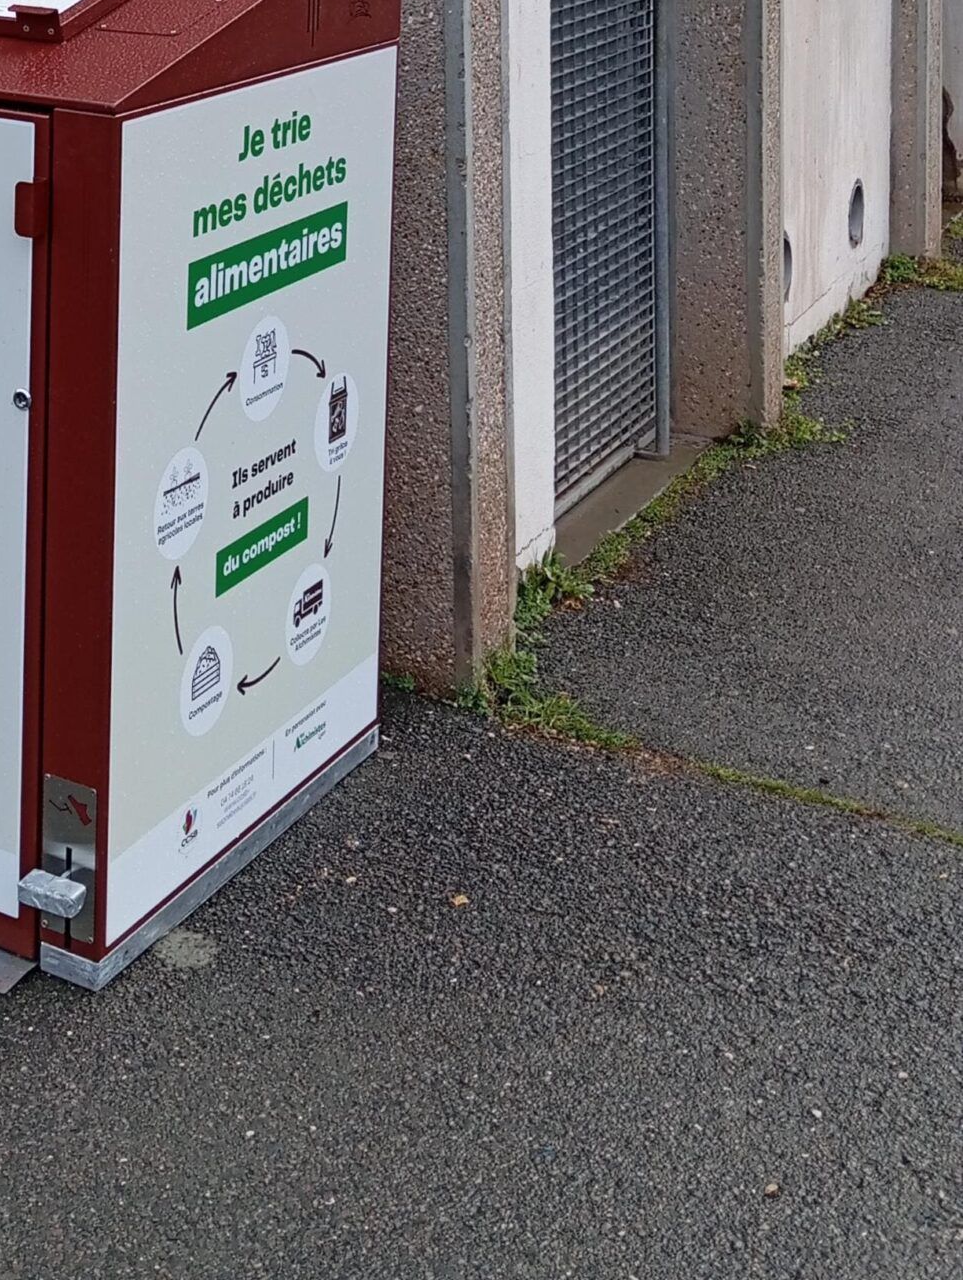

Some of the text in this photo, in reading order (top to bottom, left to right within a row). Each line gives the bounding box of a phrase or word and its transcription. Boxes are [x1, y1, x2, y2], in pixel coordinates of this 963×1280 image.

[239, 110, 311, 162] Je trie
[193, 156, 347, 238] mes déchets
[194, 222, 343, 308] alimentaires
[232, 438, 296, 489] Ils servent
[233, 472, 294, 519] à produire
[223, 555, 240, 576] du
[242, 517, 295, 564] compost
